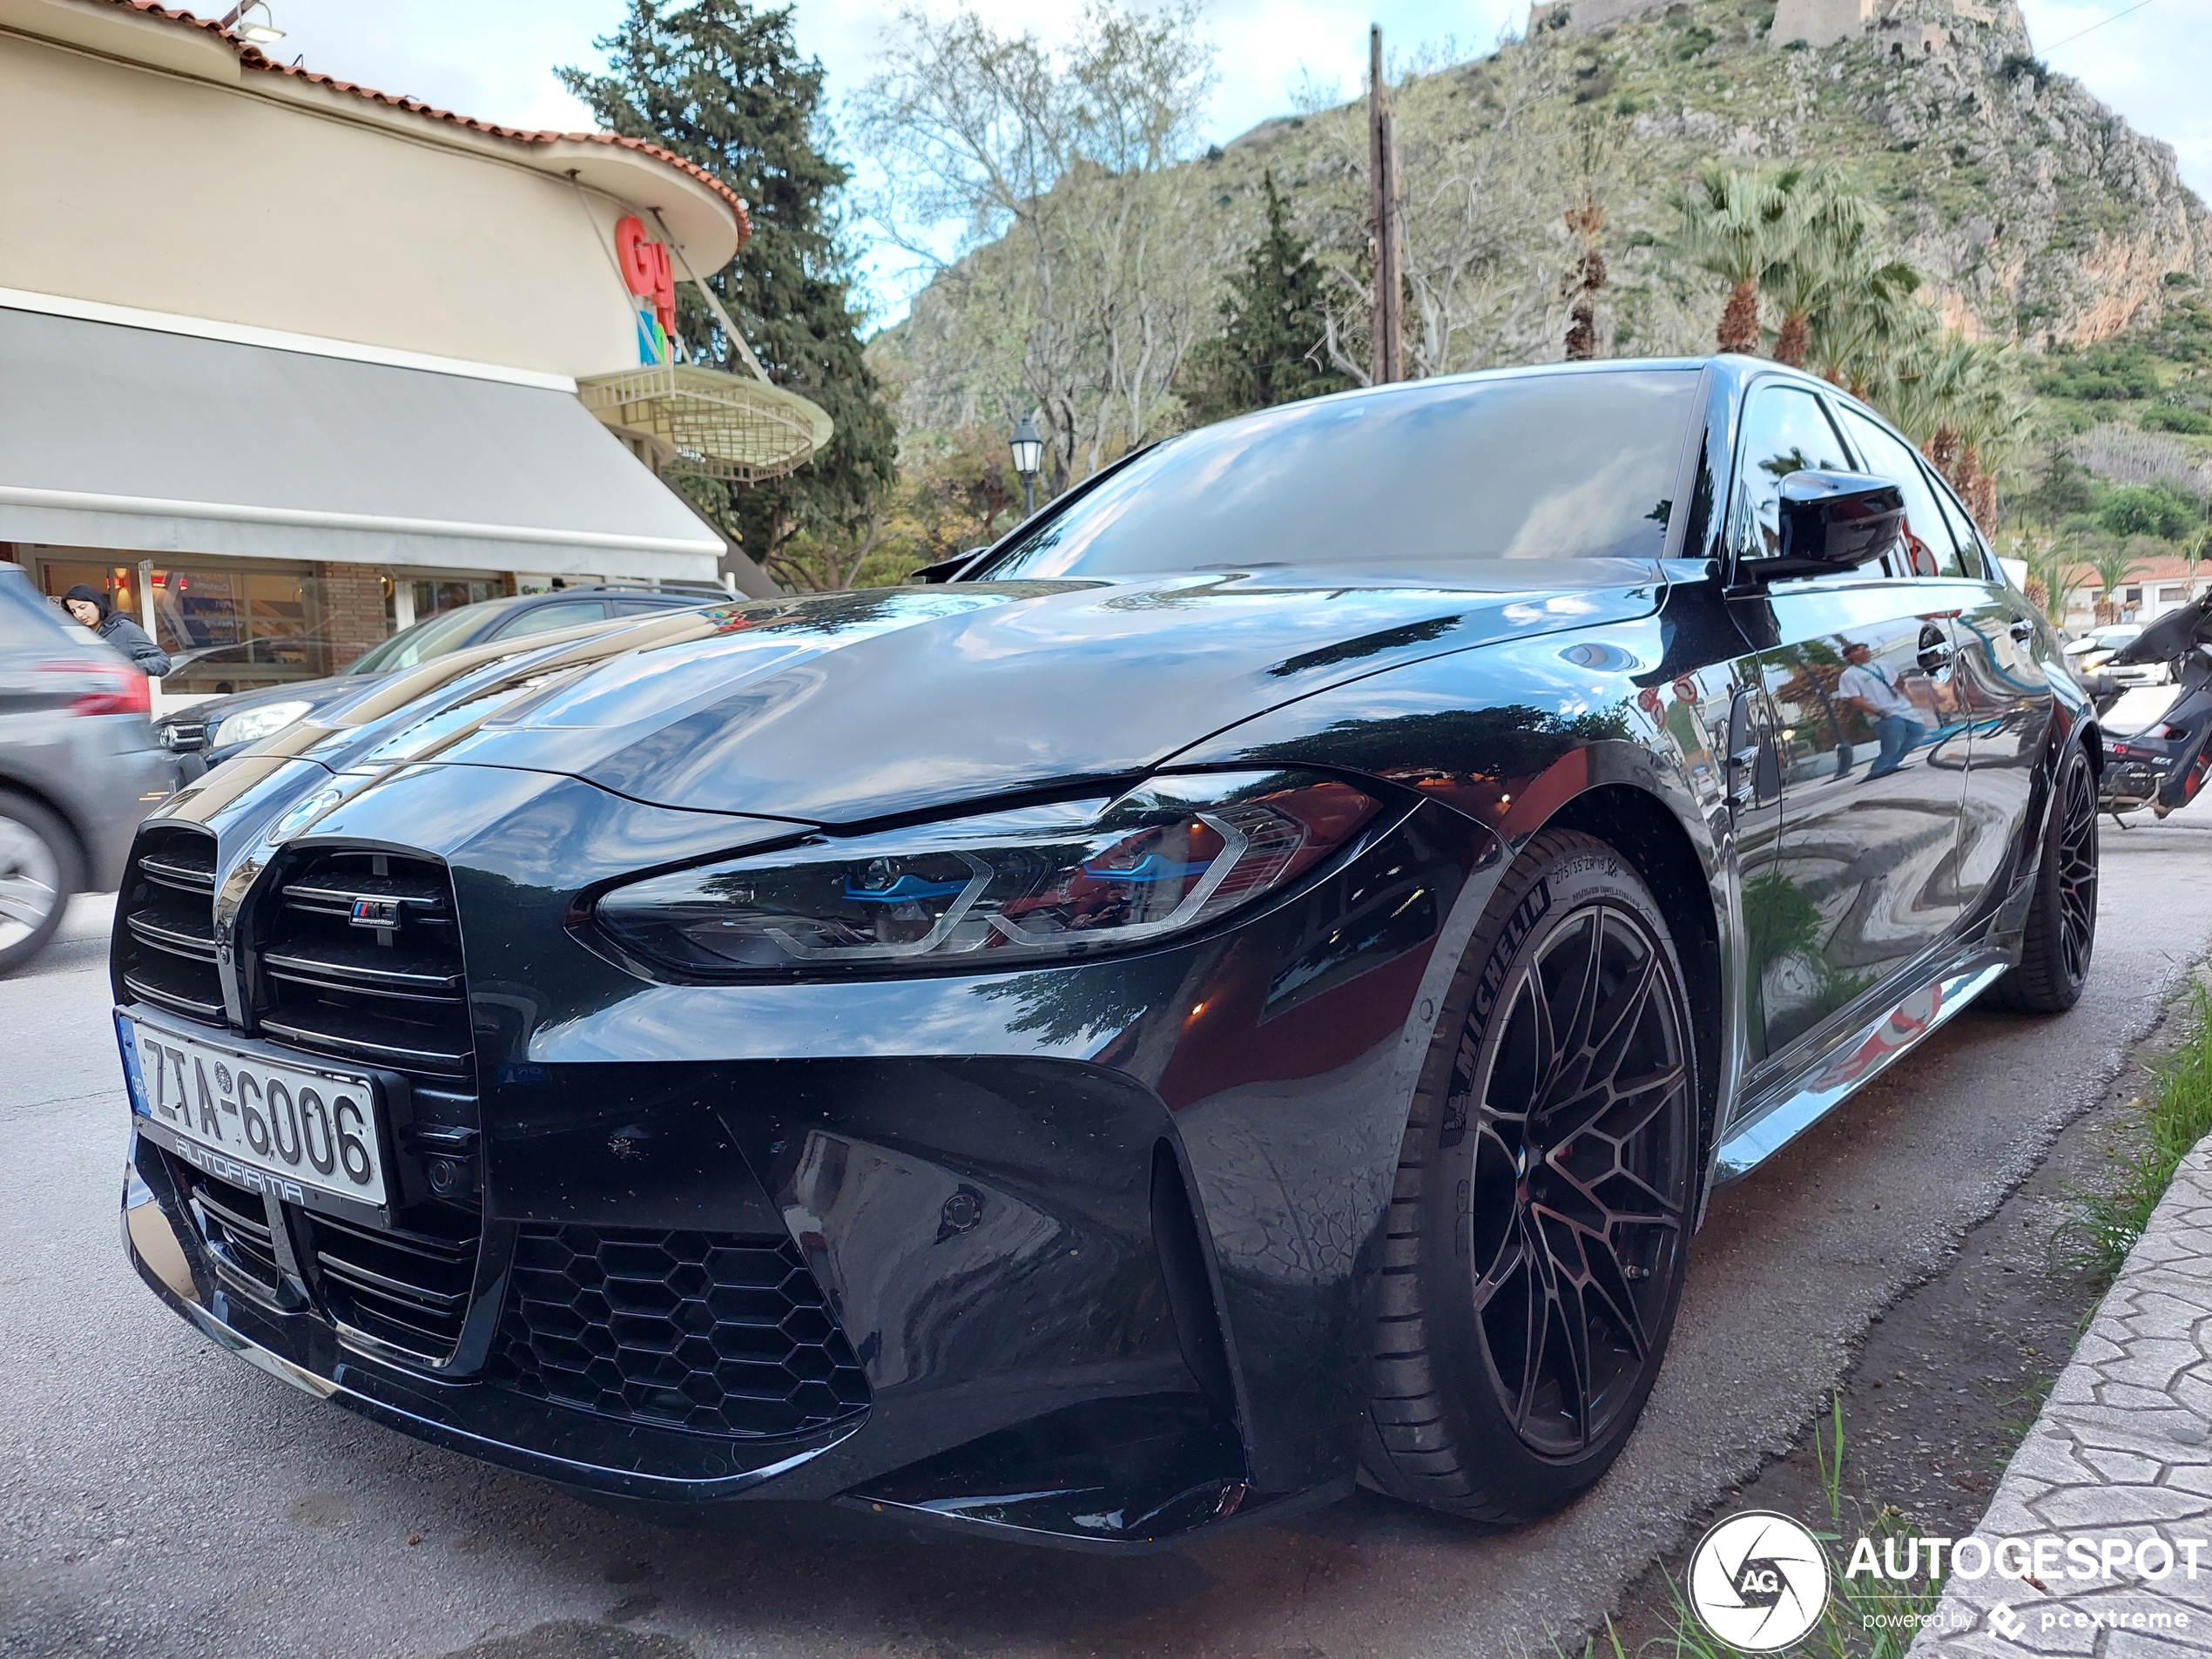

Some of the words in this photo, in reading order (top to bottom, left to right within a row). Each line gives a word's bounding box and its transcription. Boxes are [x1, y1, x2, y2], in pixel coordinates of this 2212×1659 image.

[1554, 859, 1582, 884] 275/35
[1584, 858, 1595, 870] ZR
[365, 902, 397, 918] M3
[1456, 884, 1545, 1080] MICHELIN
[131, 1075, 146, 1099] GR
[144, 1038, 372, 1185] ZTA-6006
[175, 1136, 306, 1206] AUTOFIRMA
